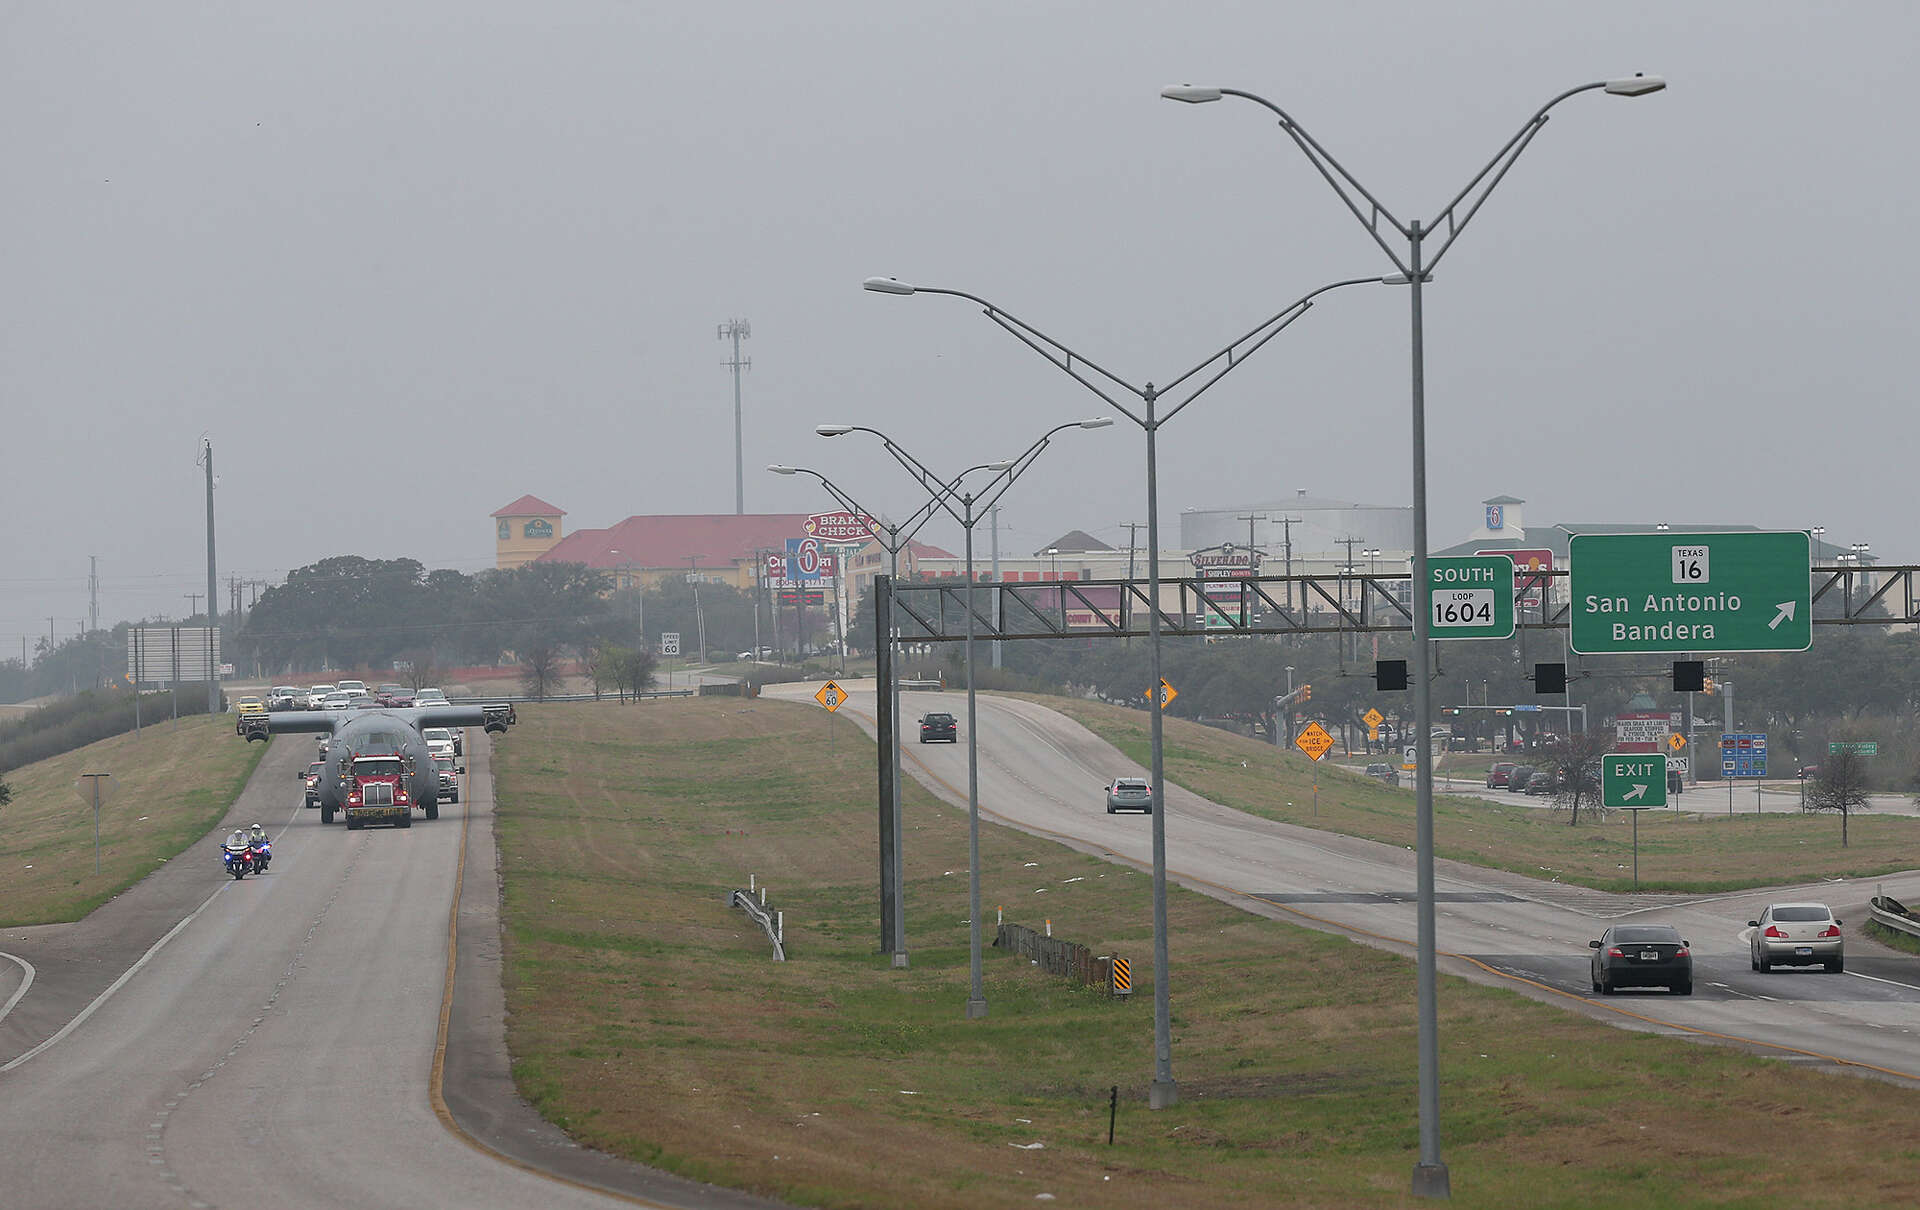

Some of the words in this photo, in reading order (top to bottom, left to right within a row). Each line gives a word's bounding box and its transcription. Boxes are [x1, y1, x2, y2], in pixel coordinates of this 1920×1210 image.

[820, 516, 865, 525] BRAKE
[819, 527, 865, 536] CHECK
[798, 538, 820, 574] 6
[1677, 549, 1704, 557] TEXAS
[1433, 567, 1494, 582] SOUTH
[1679, 559, 1702, 579] 16
[1452, 593, 1474, 601] LOOP
[1585, 595, 1629, 613] San
[1643, 592, 1742, 612] Antonio
[1435, 603, 1491, 623] 1604
[1612, 621, 1716, 641] Bandera
[664, 645, 678, 653] 60
[826, 696, 837, 706] 60
[1615, 763, 1654, 776] EXIT
